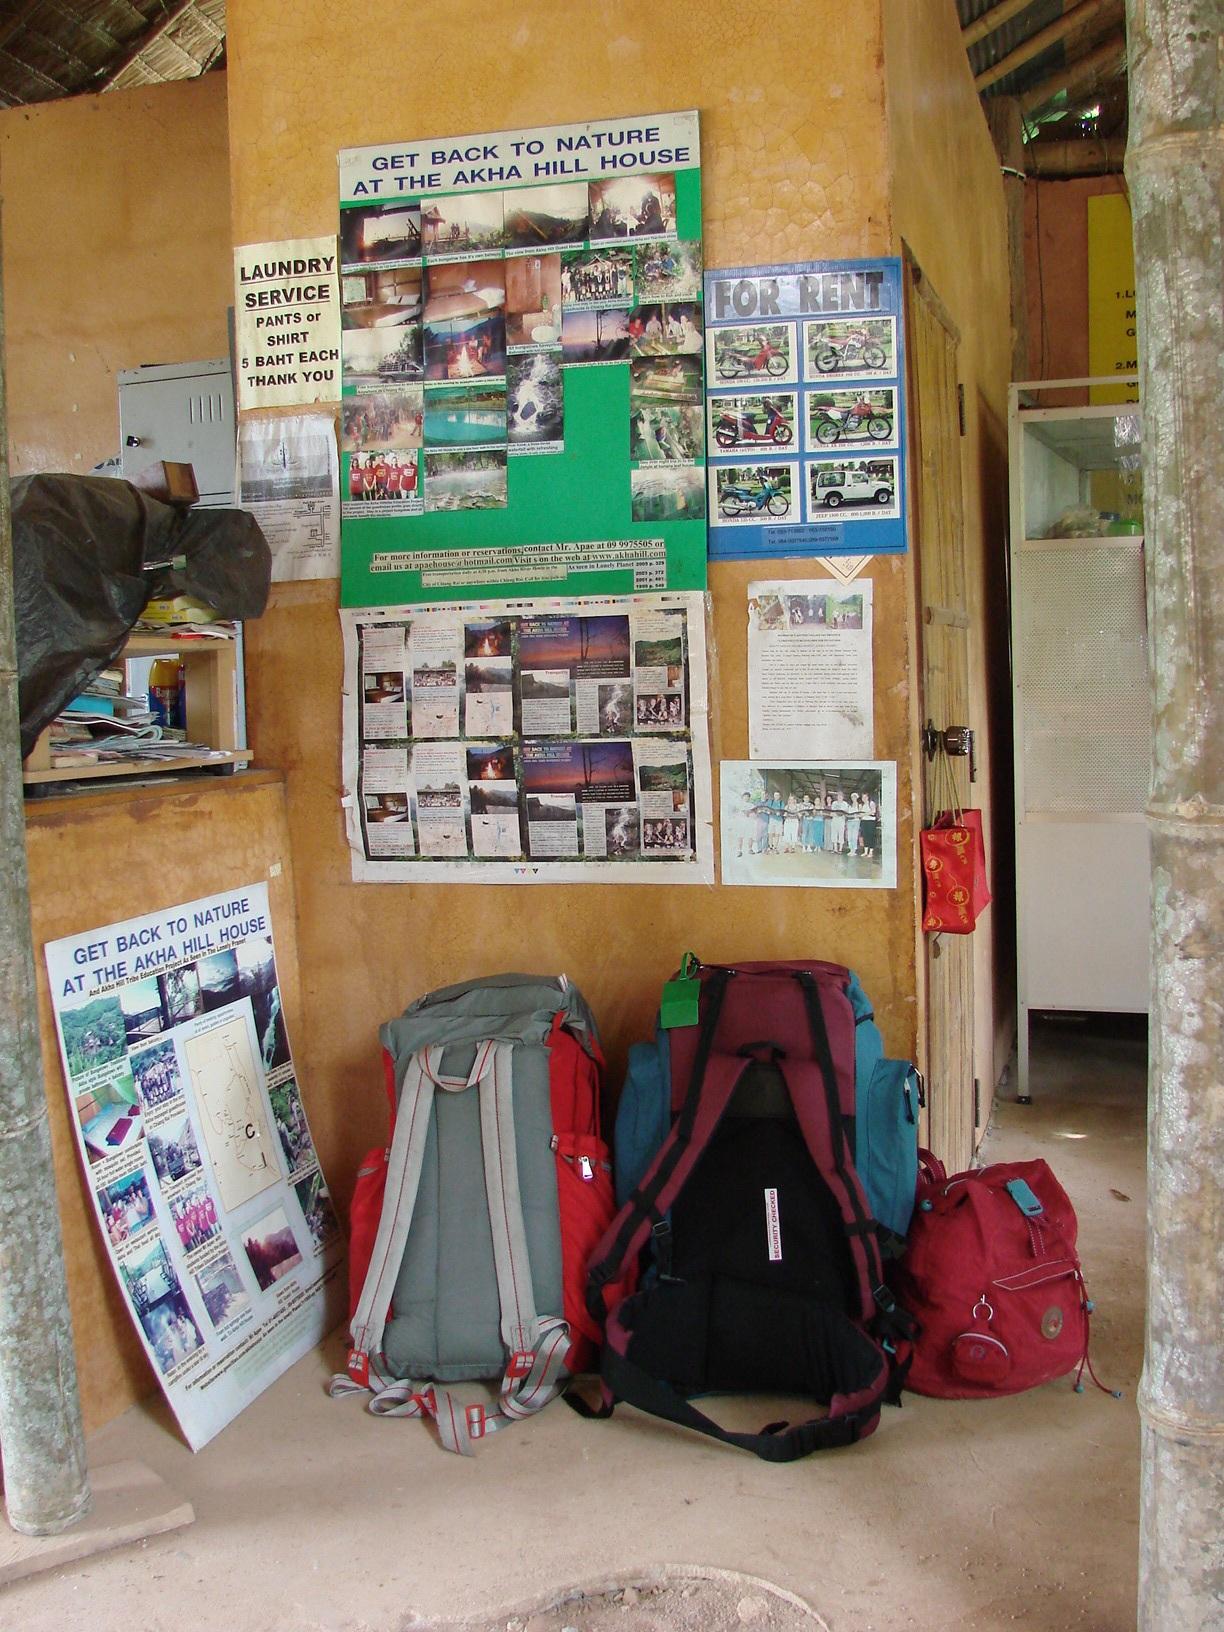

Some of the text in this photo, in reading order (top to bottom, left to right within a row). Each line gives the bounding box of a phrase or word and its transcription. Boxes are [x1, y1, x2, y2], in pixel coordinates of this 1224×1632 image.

[371, 127, 661, 171] GET BACK TO NATURE
[352, 147, 690, 196] AT THE AKHA HILL HOUSE
[240, 256, 334, 282] LAUNDRY
[245, 284, 330, 308] SERVICE
[715, 271, 884, 319] FOR RENT
[1116, 290, 1136, 299] 1.L
[256, 312, 321, 328] PANTS or
[267, 332, 309, 346] SHIRT
[242, 349, 339, 368] 5 BAHT EACH
[248, 370, 334, 387] THANK YOU
[374, 554, 388, 562] For
[412, 550, 459, 560] information
[524, 544, 553, 552] contact
[556, 543, 572, 551] Mr.
[574, 543, 595, 552] Apae
[618, 540, 652, 548] 9975505
[370, 563, 392, 572] email
[514, 556, 532, 564] Visit
[74, 898, 250, 965] GET BACK TO NATURE
[63, 916, 266, 996] AT THE AKHA HILL HOUSE
[90, 988, 100, 996] And
[102, 984, 114, 992] Akha
[116, 980, 124, 988] Hill
[126, 976, 140, 984] Tribe
[140, 966, 164, 979] Education
[166, 960, 182, 971] Project
[190, 953, 202, 961] Seen
